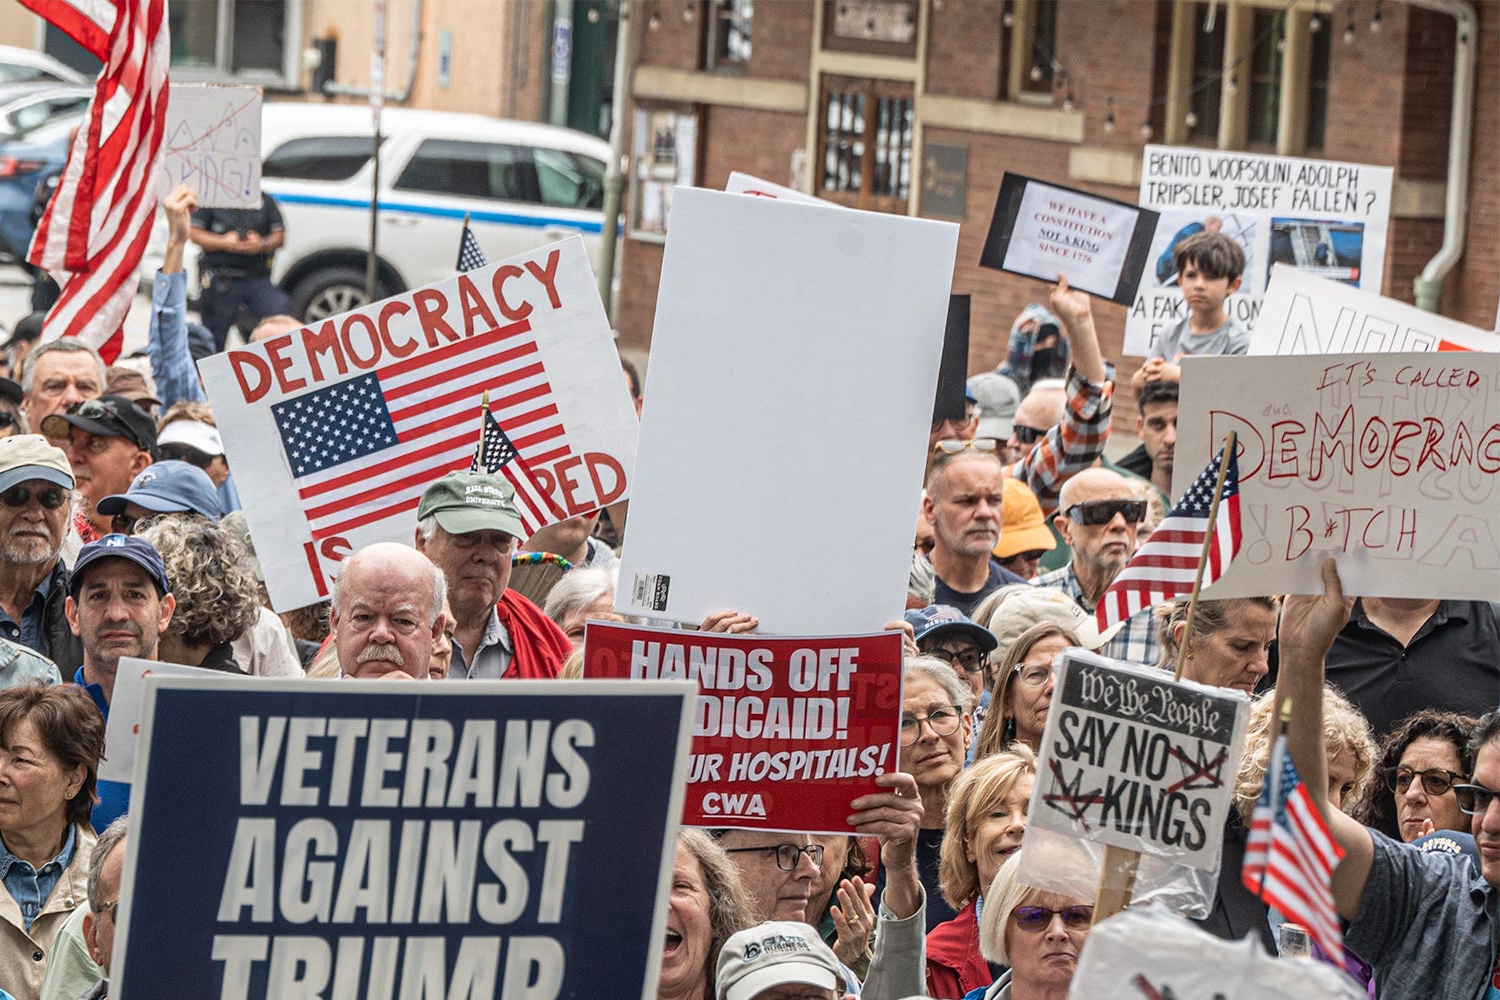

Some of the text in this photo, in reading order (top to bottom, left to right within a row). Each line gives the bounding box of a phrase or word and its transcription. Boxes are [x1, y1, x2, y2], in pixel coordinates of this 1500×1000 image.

[1149, 153, 1359, 189] BENITO WOOPSOLINI, ADOLPH
[1049, 201, 1065, 213] WE
[1067, 206, 1096, 221] HAVE
[1148, 182, 1226, 211] TRIPSLER,
[1229, 186, 1279, 208] JOSEF
[1291, 190, 1358, 213] FALLEN
[1034, 212, 1113, 240] CONSTITUTION
[1040, 228, 1061, 242] NOT
[1072, 238, 1100, 253] KING
[1038, 243, 1068, 259] SINCE
[229, 249, 562, 403] DEMOCRACY
[1133, 295, 1187, 319] A FAK
[1316, 361, 1481, 391] IT'S CALLED
[1210, 404, 1500, 483] DEMOCRAC
[630, 640, 859, 692] HANDS OFF
[696, 697, 850, 740] DICAID!
[1080, 667, 1114, 711] We
[1144, 685, 1220, 734] People
[239, 715, 595, 808] VETERANS
[686, 742, 891, 784] UR HOSPITALS!
[1054, 711, 1171, 782] SAY NO
[702, 792, 766, 817] CWA
[1099, 776, 1211, 851] KINGS
[216, 818, 584, 924] AGAINST
